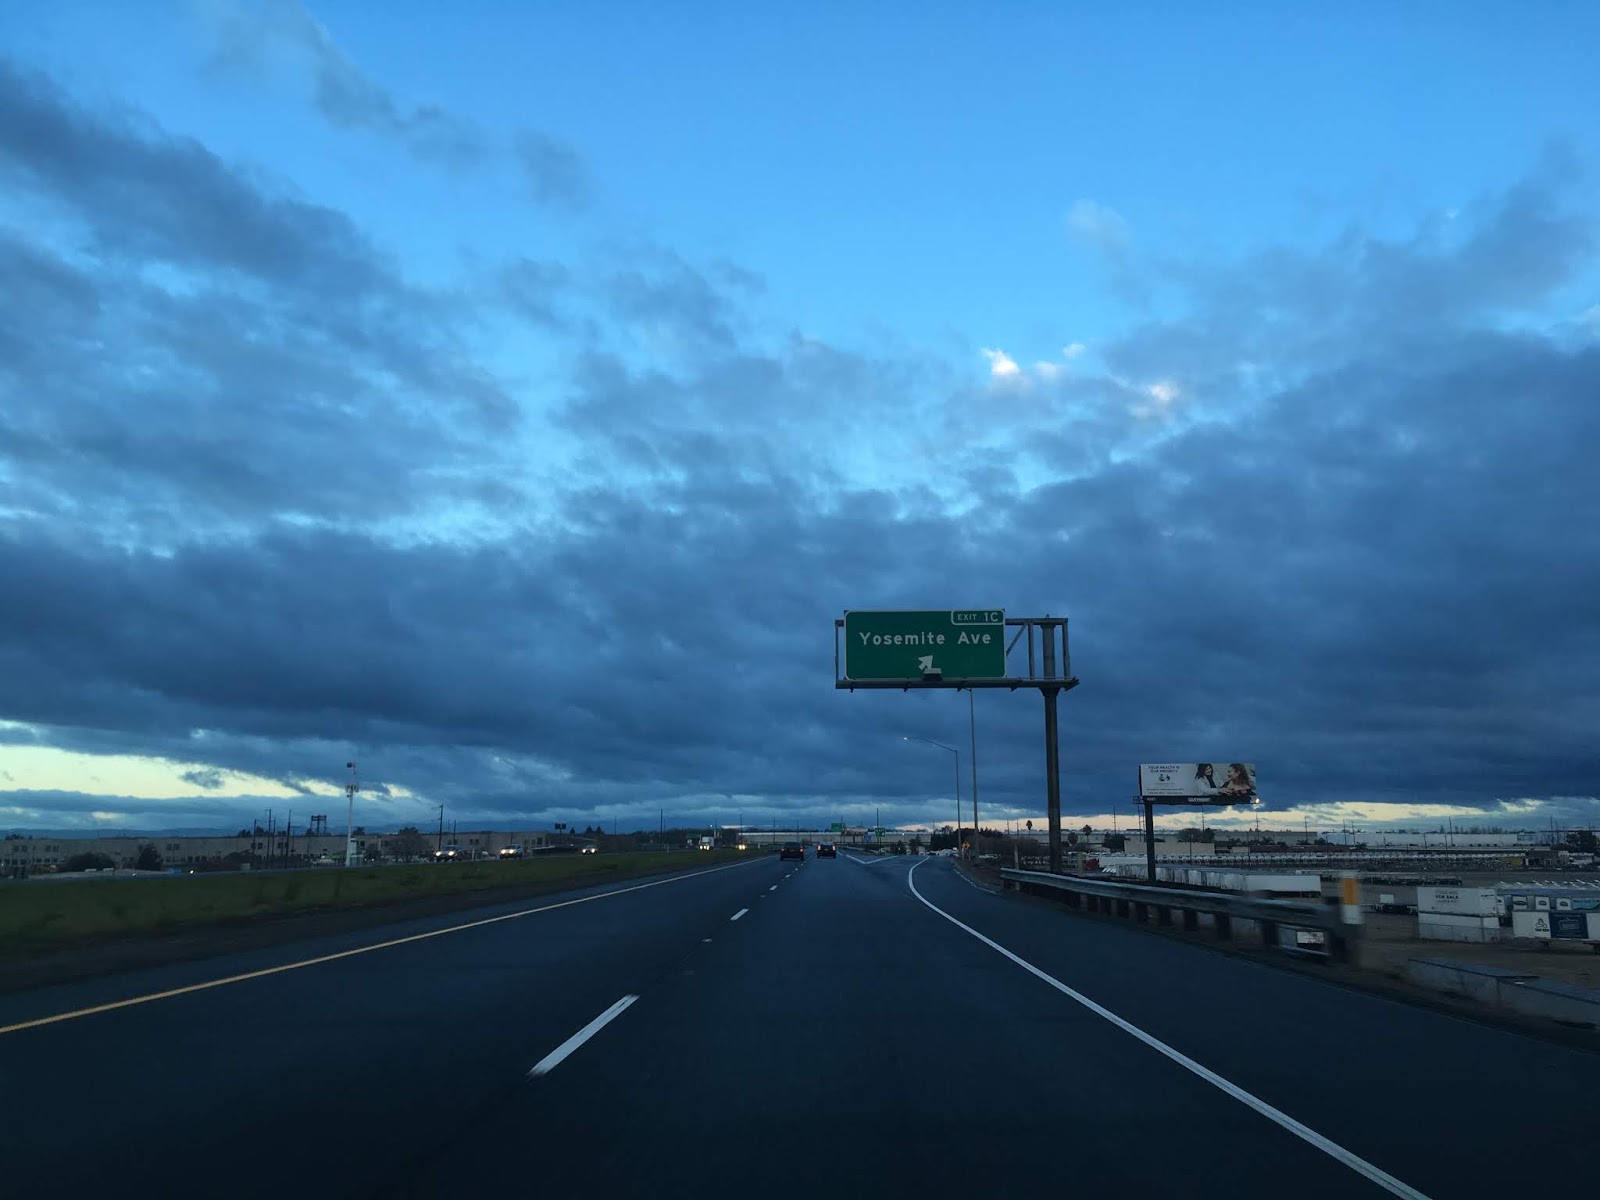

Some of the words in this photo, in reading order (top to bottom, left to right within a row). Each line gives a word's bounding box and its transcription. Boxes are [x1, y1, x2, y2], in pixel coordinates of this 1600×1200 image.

[957, 613, 977, 621] EXIT
[984, 612, 999, 622] 1C
[859, 631, 945, 645] Yosemite
[957, 631, 992, 645] Ave
